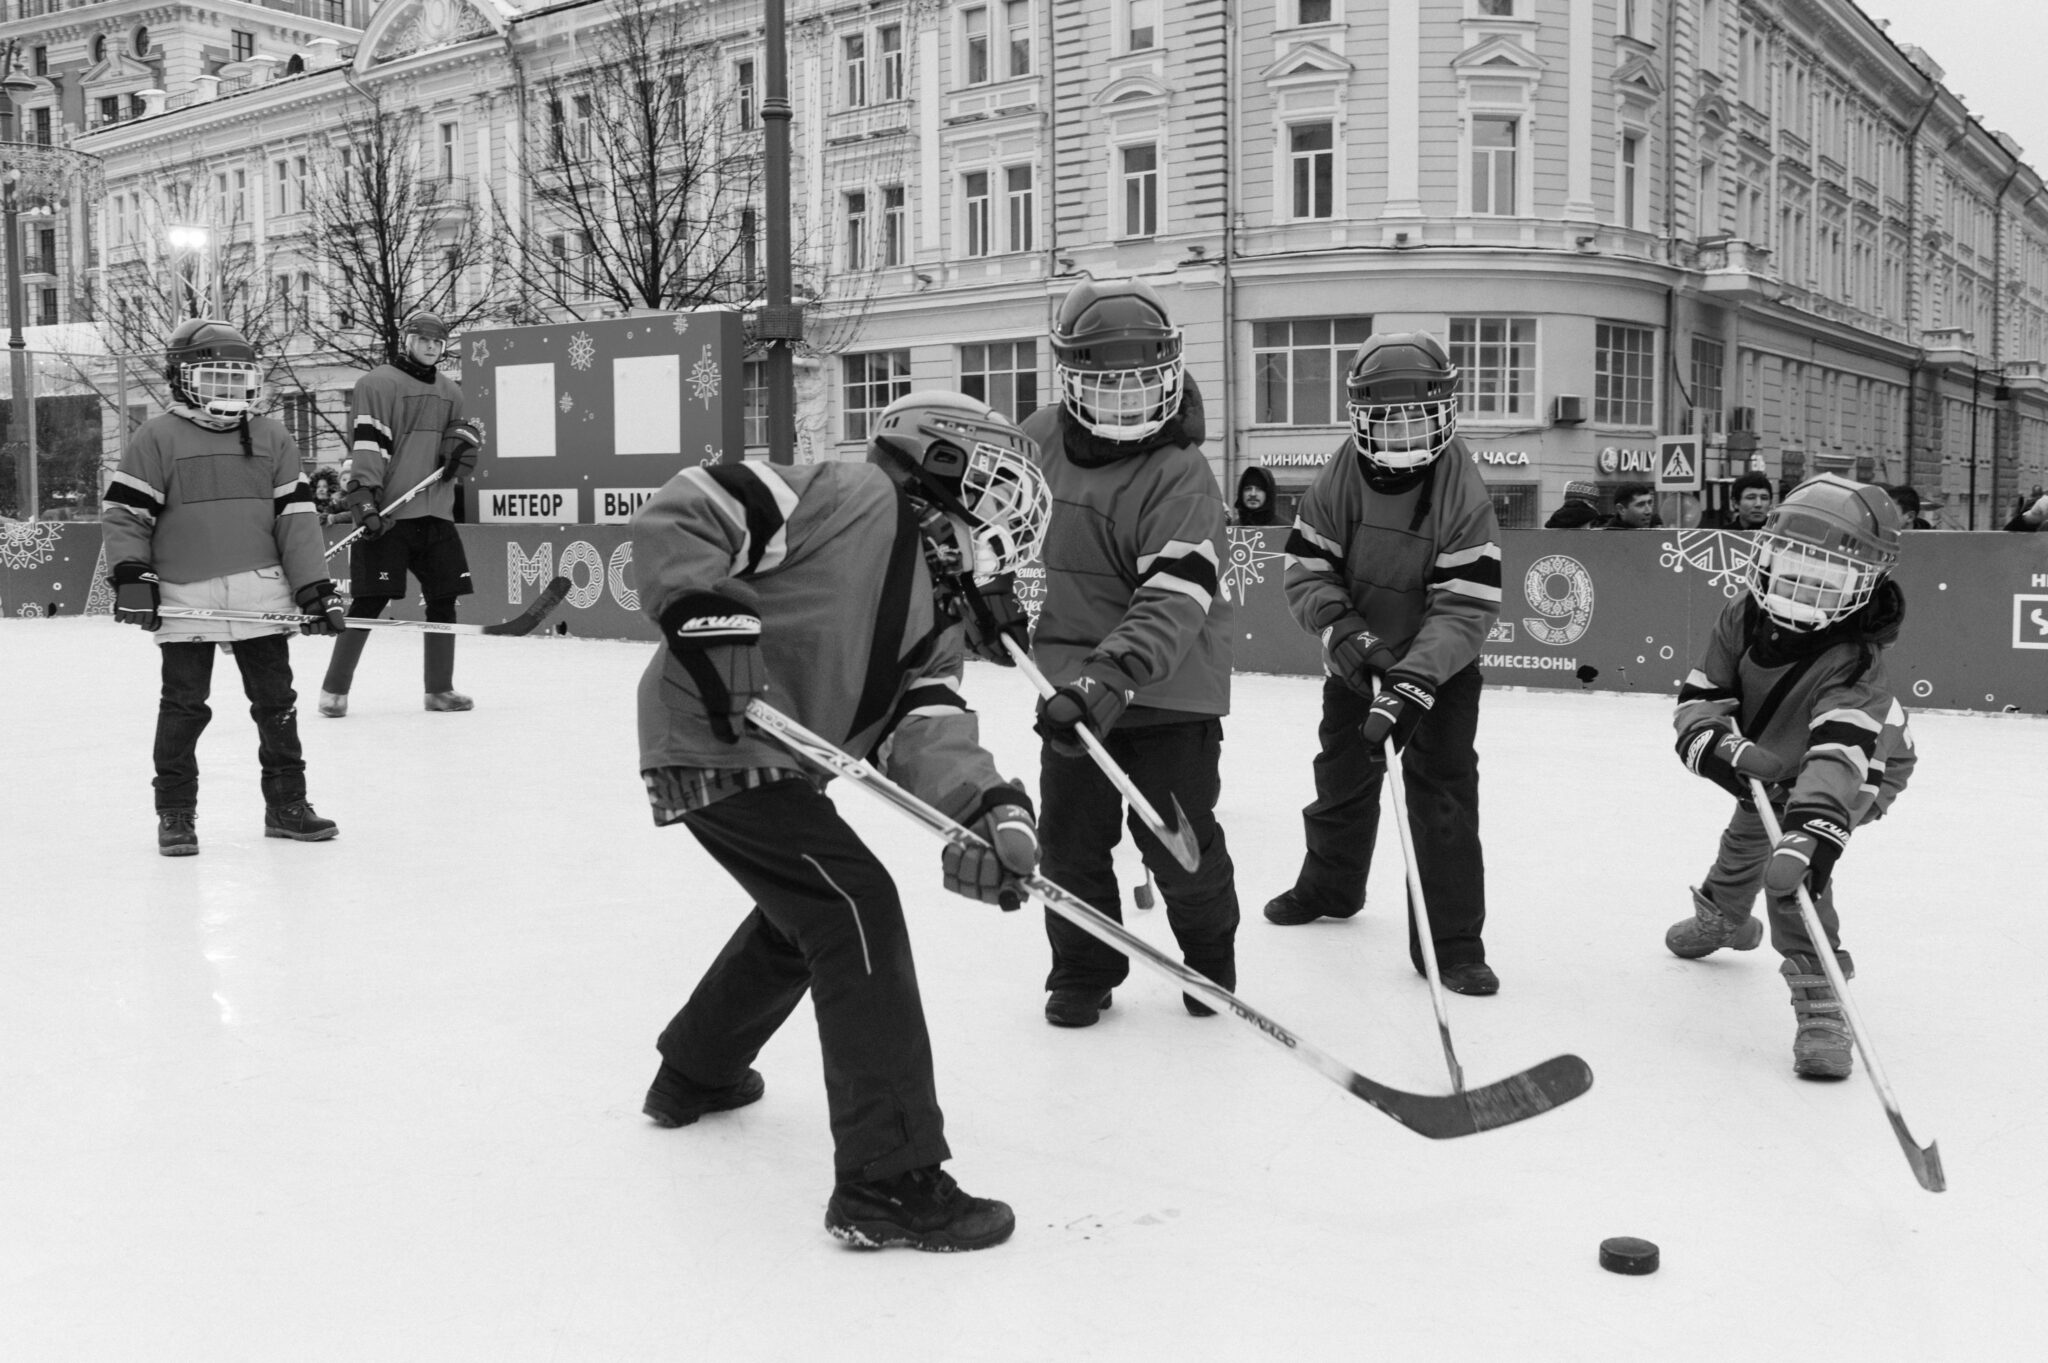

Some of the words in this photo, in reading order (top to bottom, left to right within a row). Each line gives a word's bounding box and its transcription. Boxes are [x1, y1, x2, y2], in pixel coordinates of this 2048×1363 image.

[1260, 453, 1333, 467] МИНИМАР
[1482, 451, 1530, 465] ЧАСА
[1620, 449, 1657, 472] DAILY
[493, 493, 563, 516] МЕТЕОР
[1485, 554, 1595, 646] 9
[1228, 1001, 1297, 1049] TORNADO
